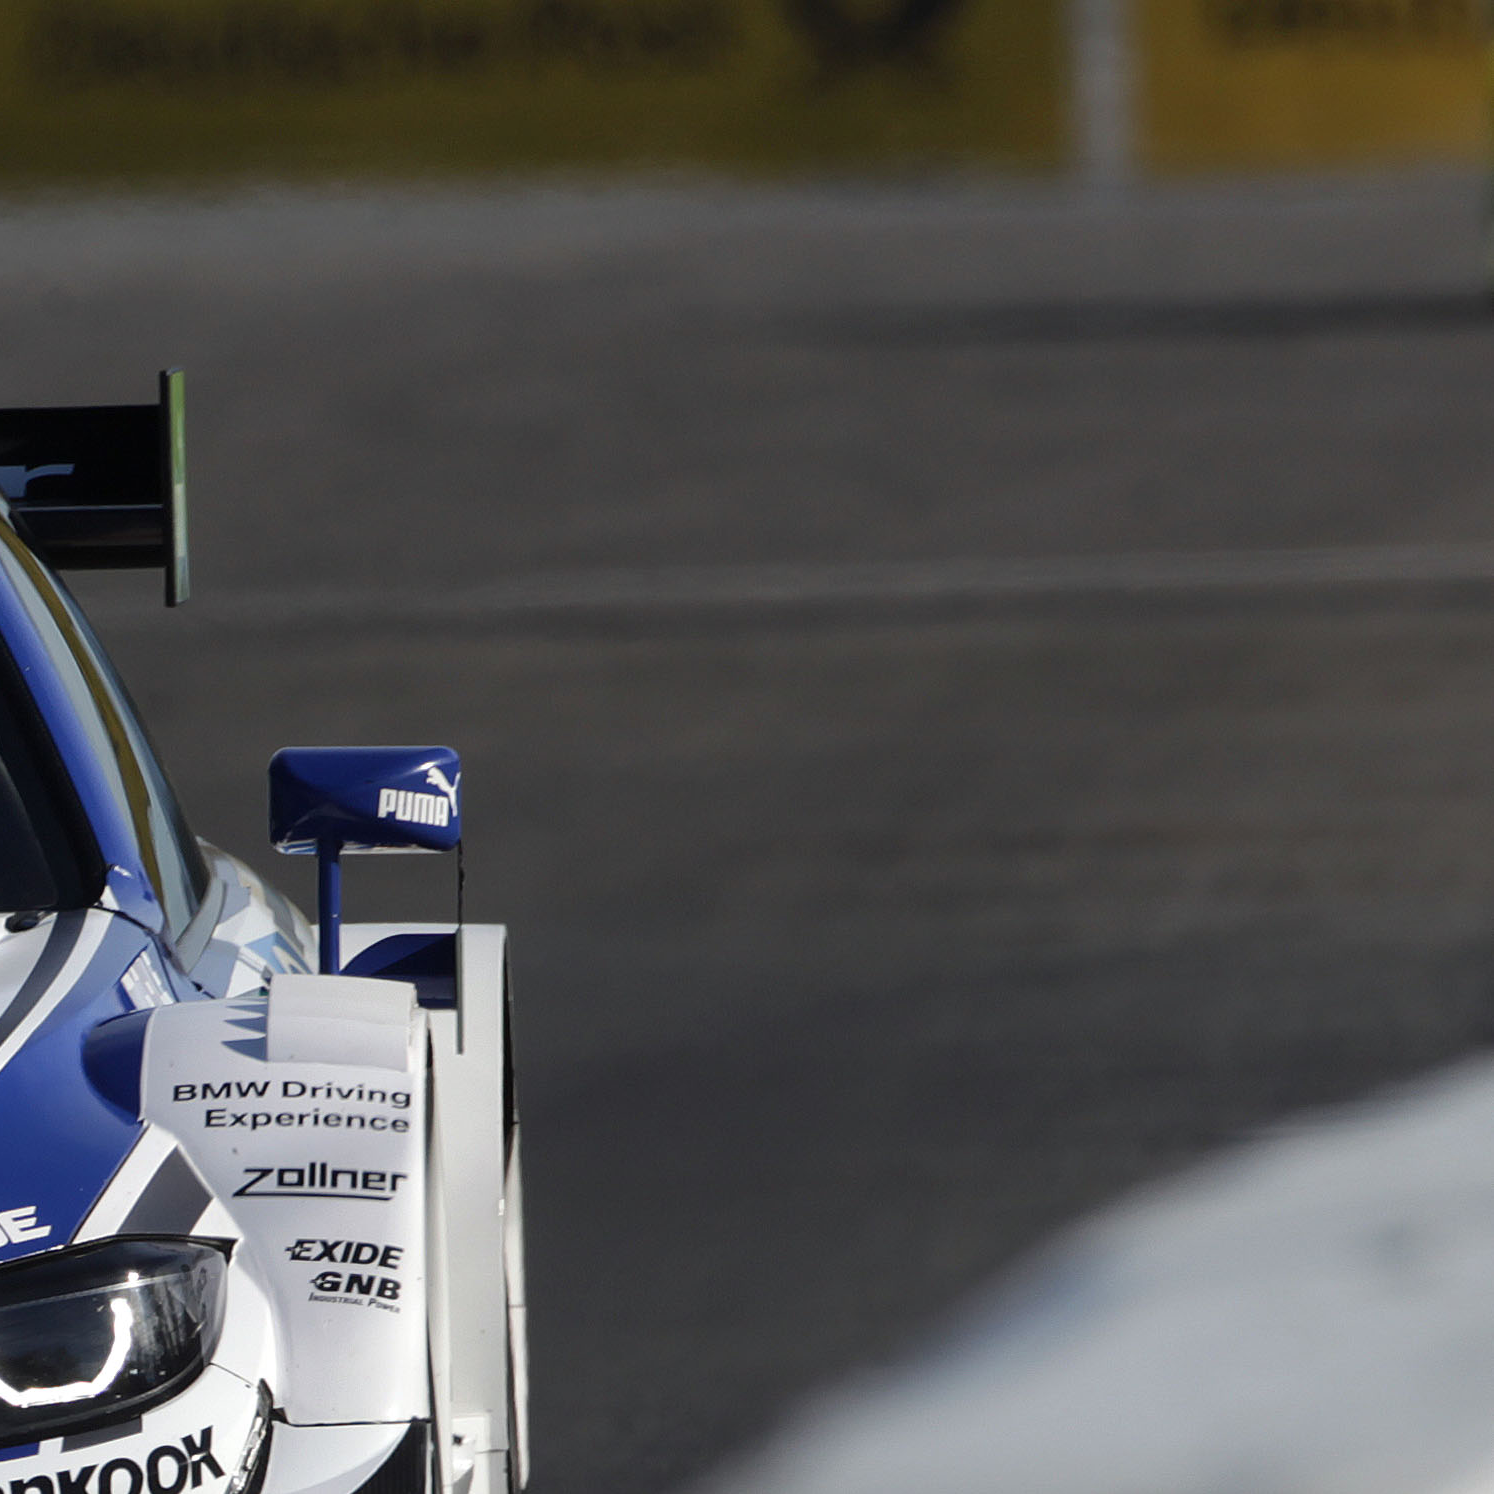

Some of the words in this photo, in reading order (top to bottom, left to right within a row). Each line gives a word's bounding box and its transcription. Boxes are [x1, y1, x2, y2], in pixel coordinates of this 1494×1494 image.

[377, 787, 449, 827] PUMA
[172, 1081, 271, 1102] BMW
[282, 1081, 412, 1109] Driving
[204, 1108, 410, 1133] Experience
[284, 1238, 404, 1270] EXIDE
[309, 1270, 402, 1300] GNB
